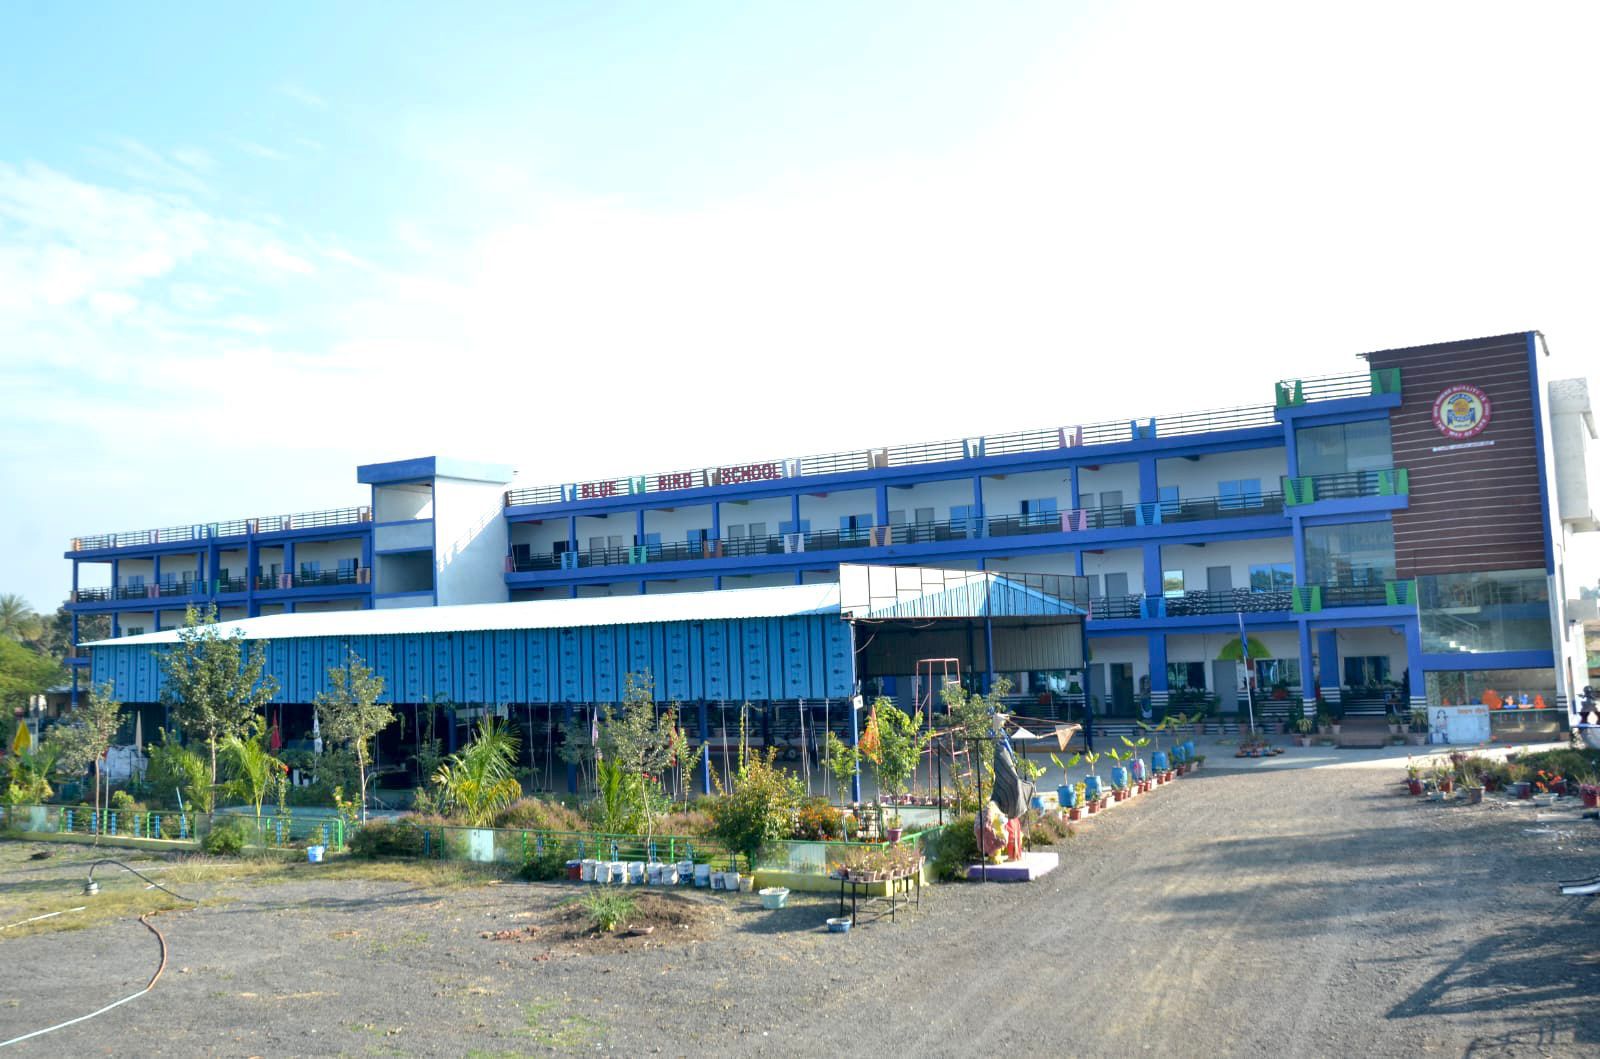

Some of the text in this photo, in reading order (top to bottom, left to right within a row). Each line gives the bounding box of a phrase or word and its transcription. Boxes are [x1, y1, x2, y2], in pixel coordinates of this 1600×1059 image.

[581, 463, 782, 498] BLUE BIRD SCHOOL
